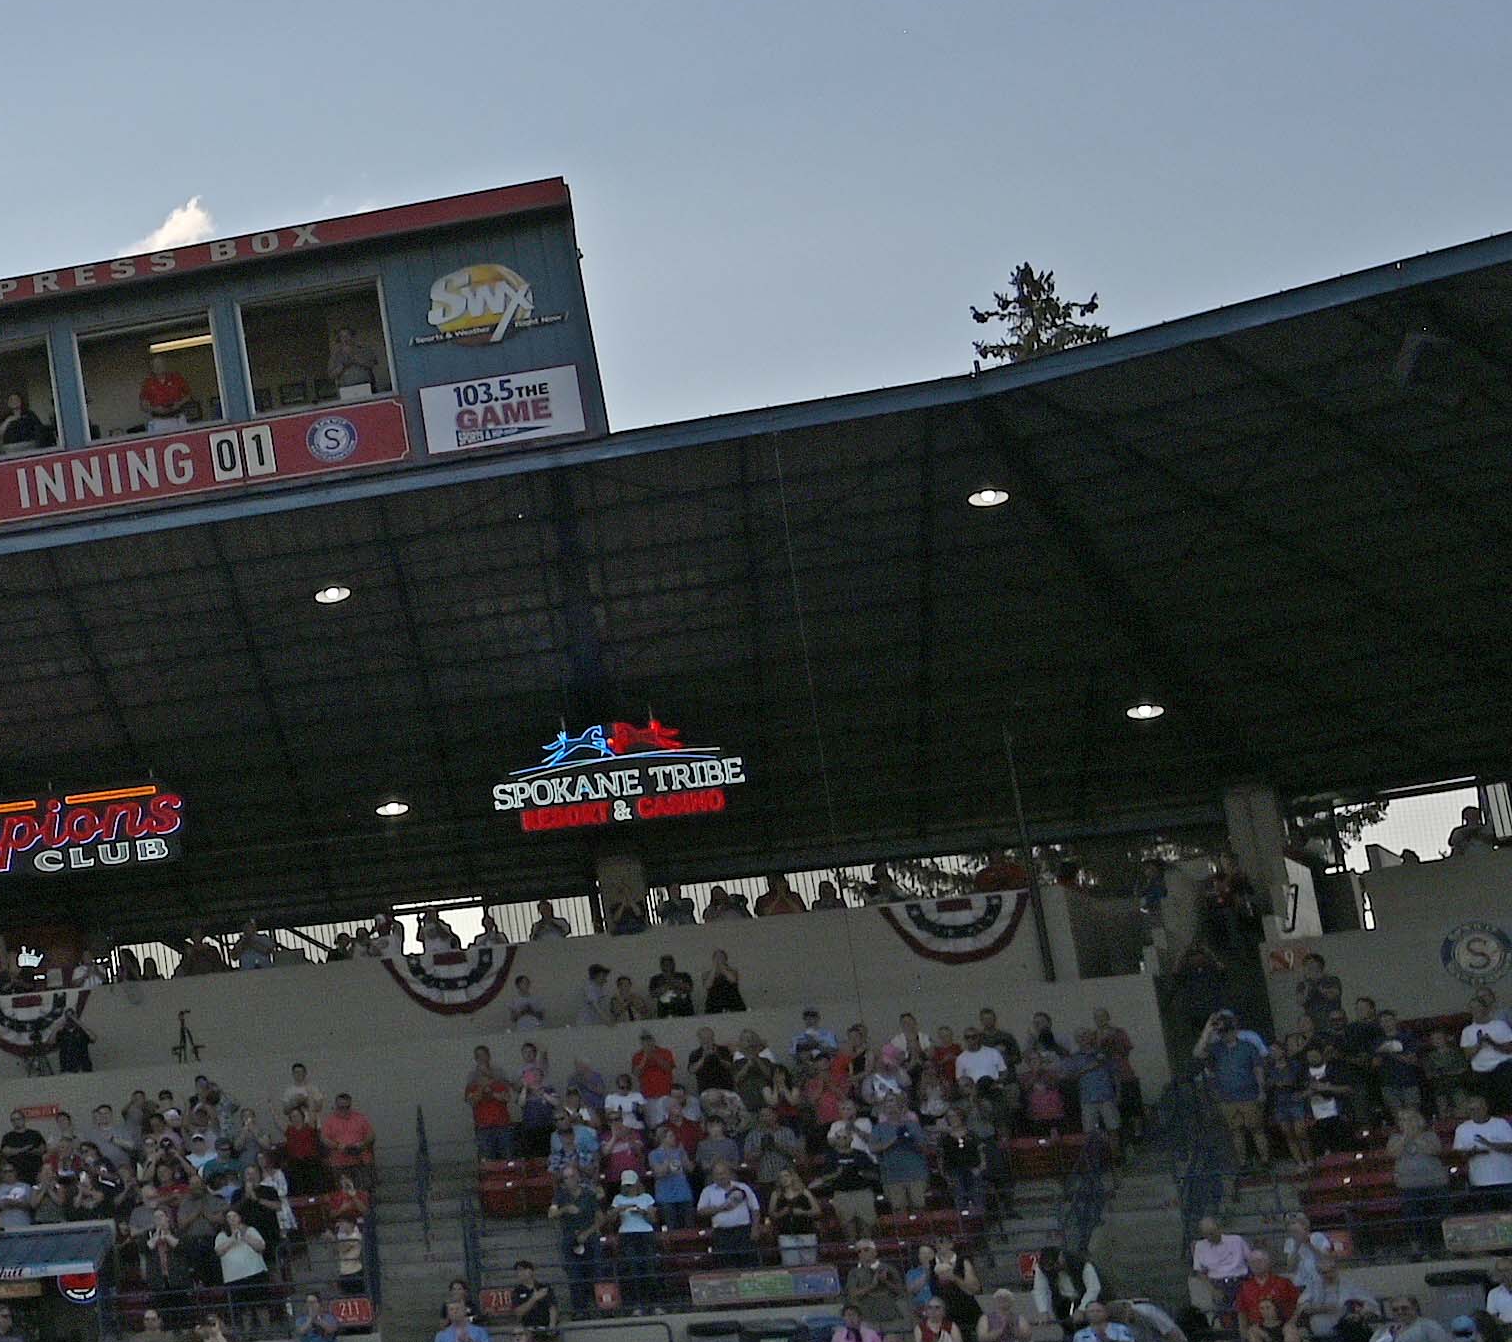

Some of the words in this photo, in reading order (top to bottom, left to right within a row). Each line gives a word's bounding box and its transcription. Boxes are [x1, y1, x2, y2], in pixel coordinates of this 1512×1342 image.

[210, 224, 320, 262] BOX
[453, 378, 514, 408] 103.5
[515, 382, 550, 398] THE
[456, 396, 553, 430] GAME
[216, 431, 271, 473] 01
[17, 442, 194, 509] INNING
[492, 769, 644, 811] SPOKANE
[648, 757, 746, 792] TRIBE
[520, 802, 610, 832] RESORT
[613, 799, 633, 822] &
[637, 789, 726, 819] CASINO
[33, 837, 169, 872] CLUB
[340, 1302, 361, 1317] 211
